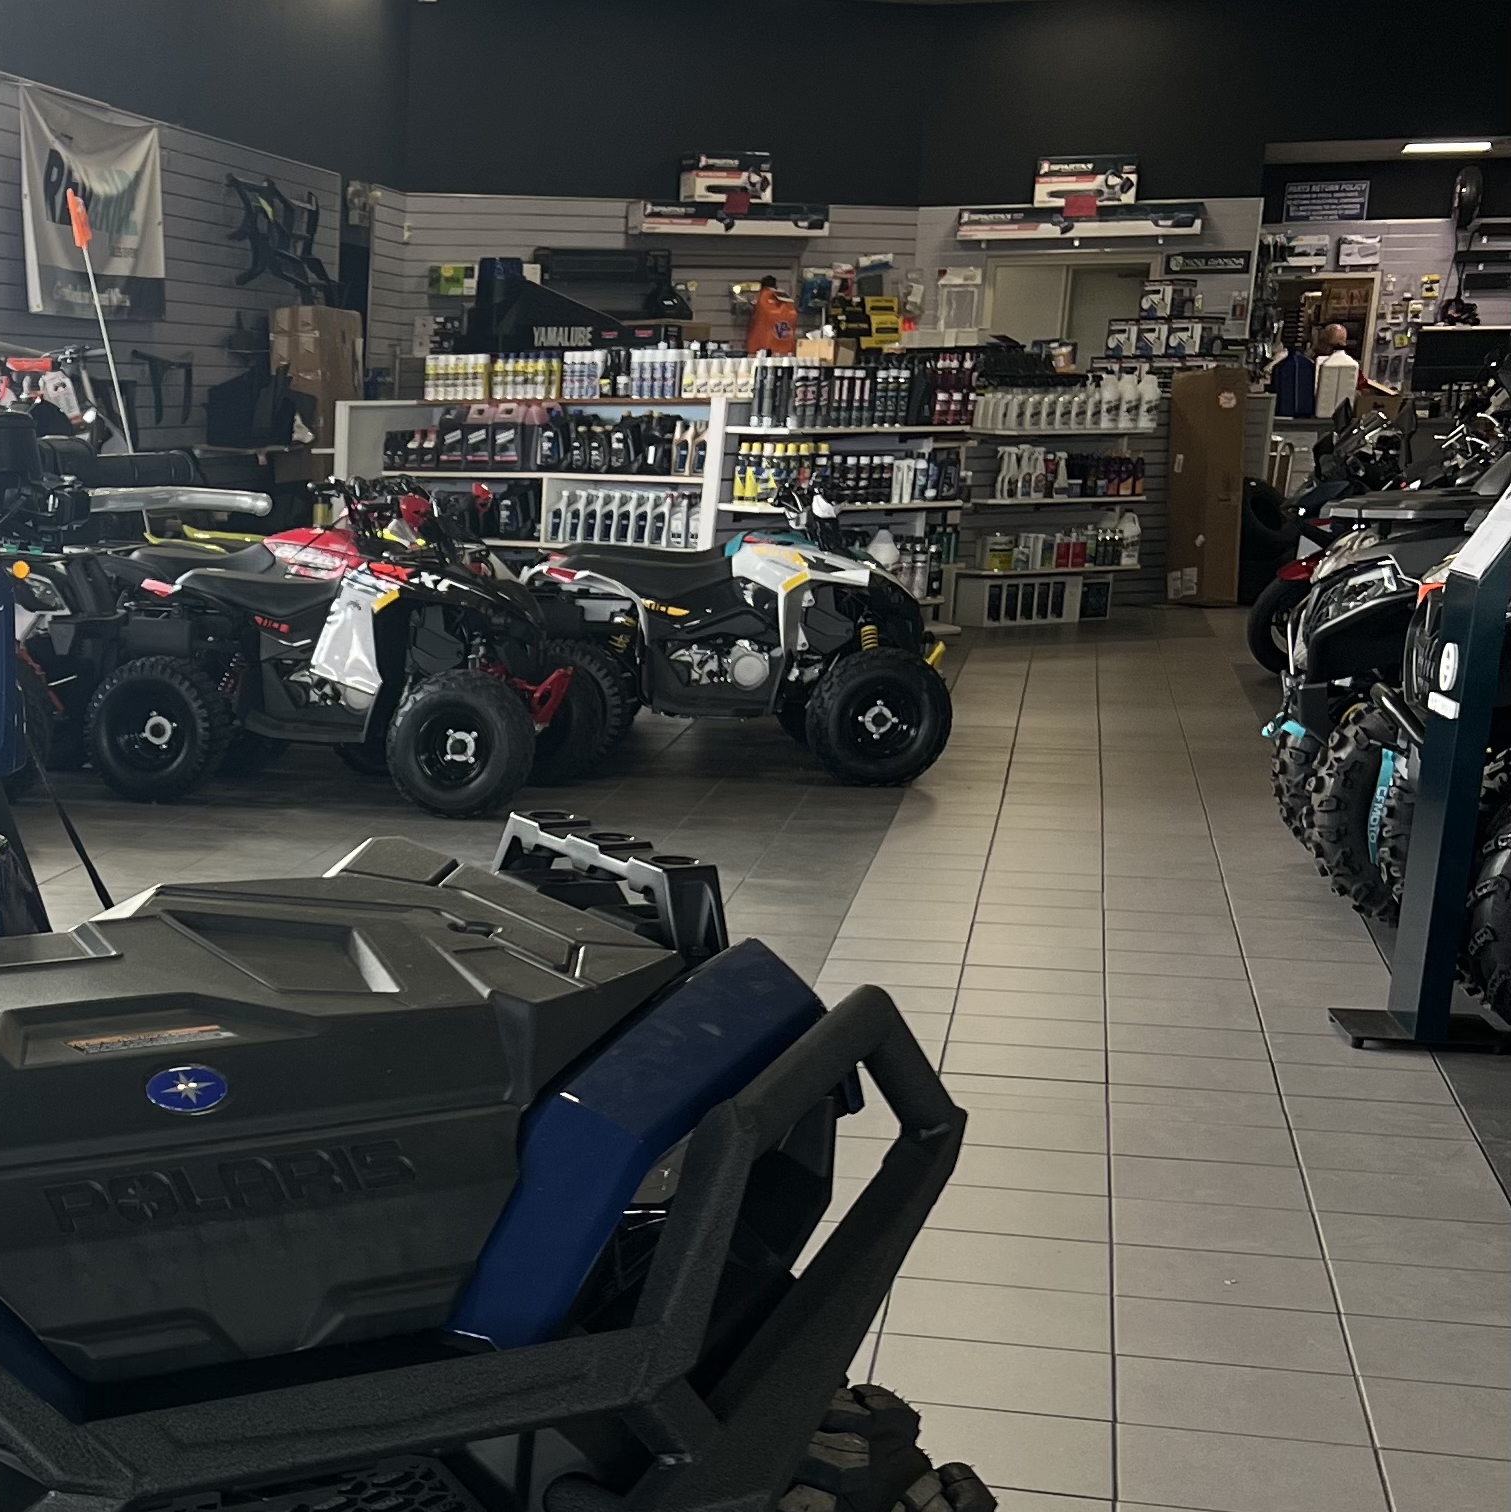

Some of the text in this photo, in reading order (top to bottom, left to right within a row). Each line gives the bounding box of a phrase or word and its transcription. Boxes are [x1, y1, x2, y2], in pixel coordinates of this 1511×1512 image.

[1340, 183, 1367, 191] POLICY
[533, 326, 593, 347] YAMALUBE
[1369, 786, 1388, 843] CFMOTO
[43, 1138, 418, 1234] POLARIS
